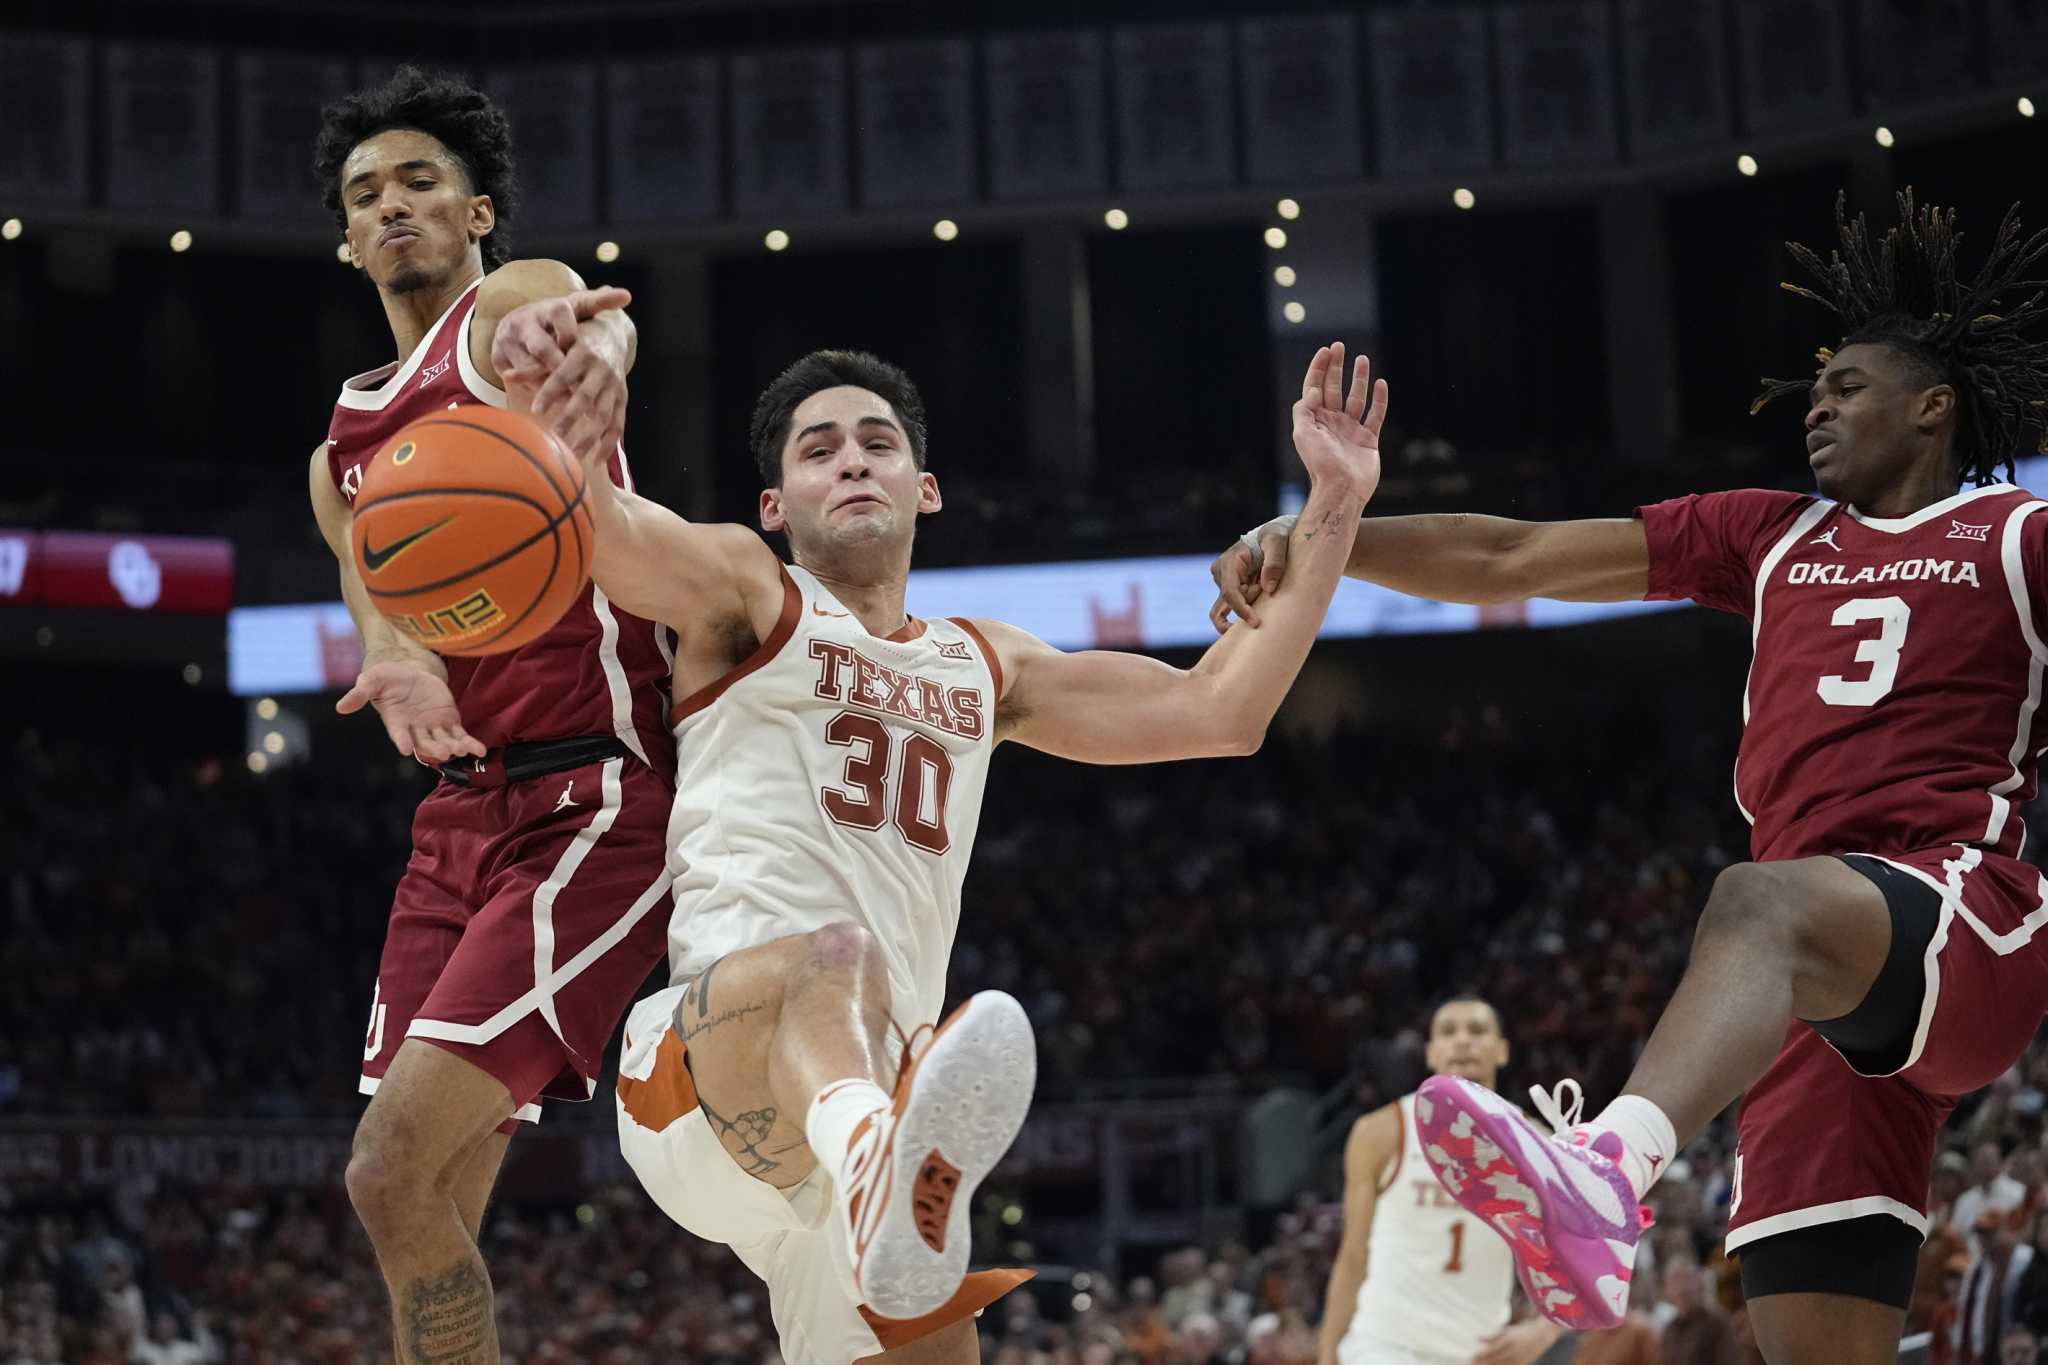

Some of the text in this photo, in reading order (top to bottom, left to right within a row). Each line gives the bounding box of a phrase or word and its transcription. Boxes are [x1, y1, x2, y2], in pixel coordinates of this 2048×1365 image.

[1787, 558, 1981, 588] OKLAHOMA
[809, 638, 985, 740] TEXAS
[1816, 595, 1912, 707] 3
[820, 709, 955, 856] 30
[1443, 1222, 1464, 1272] 1
